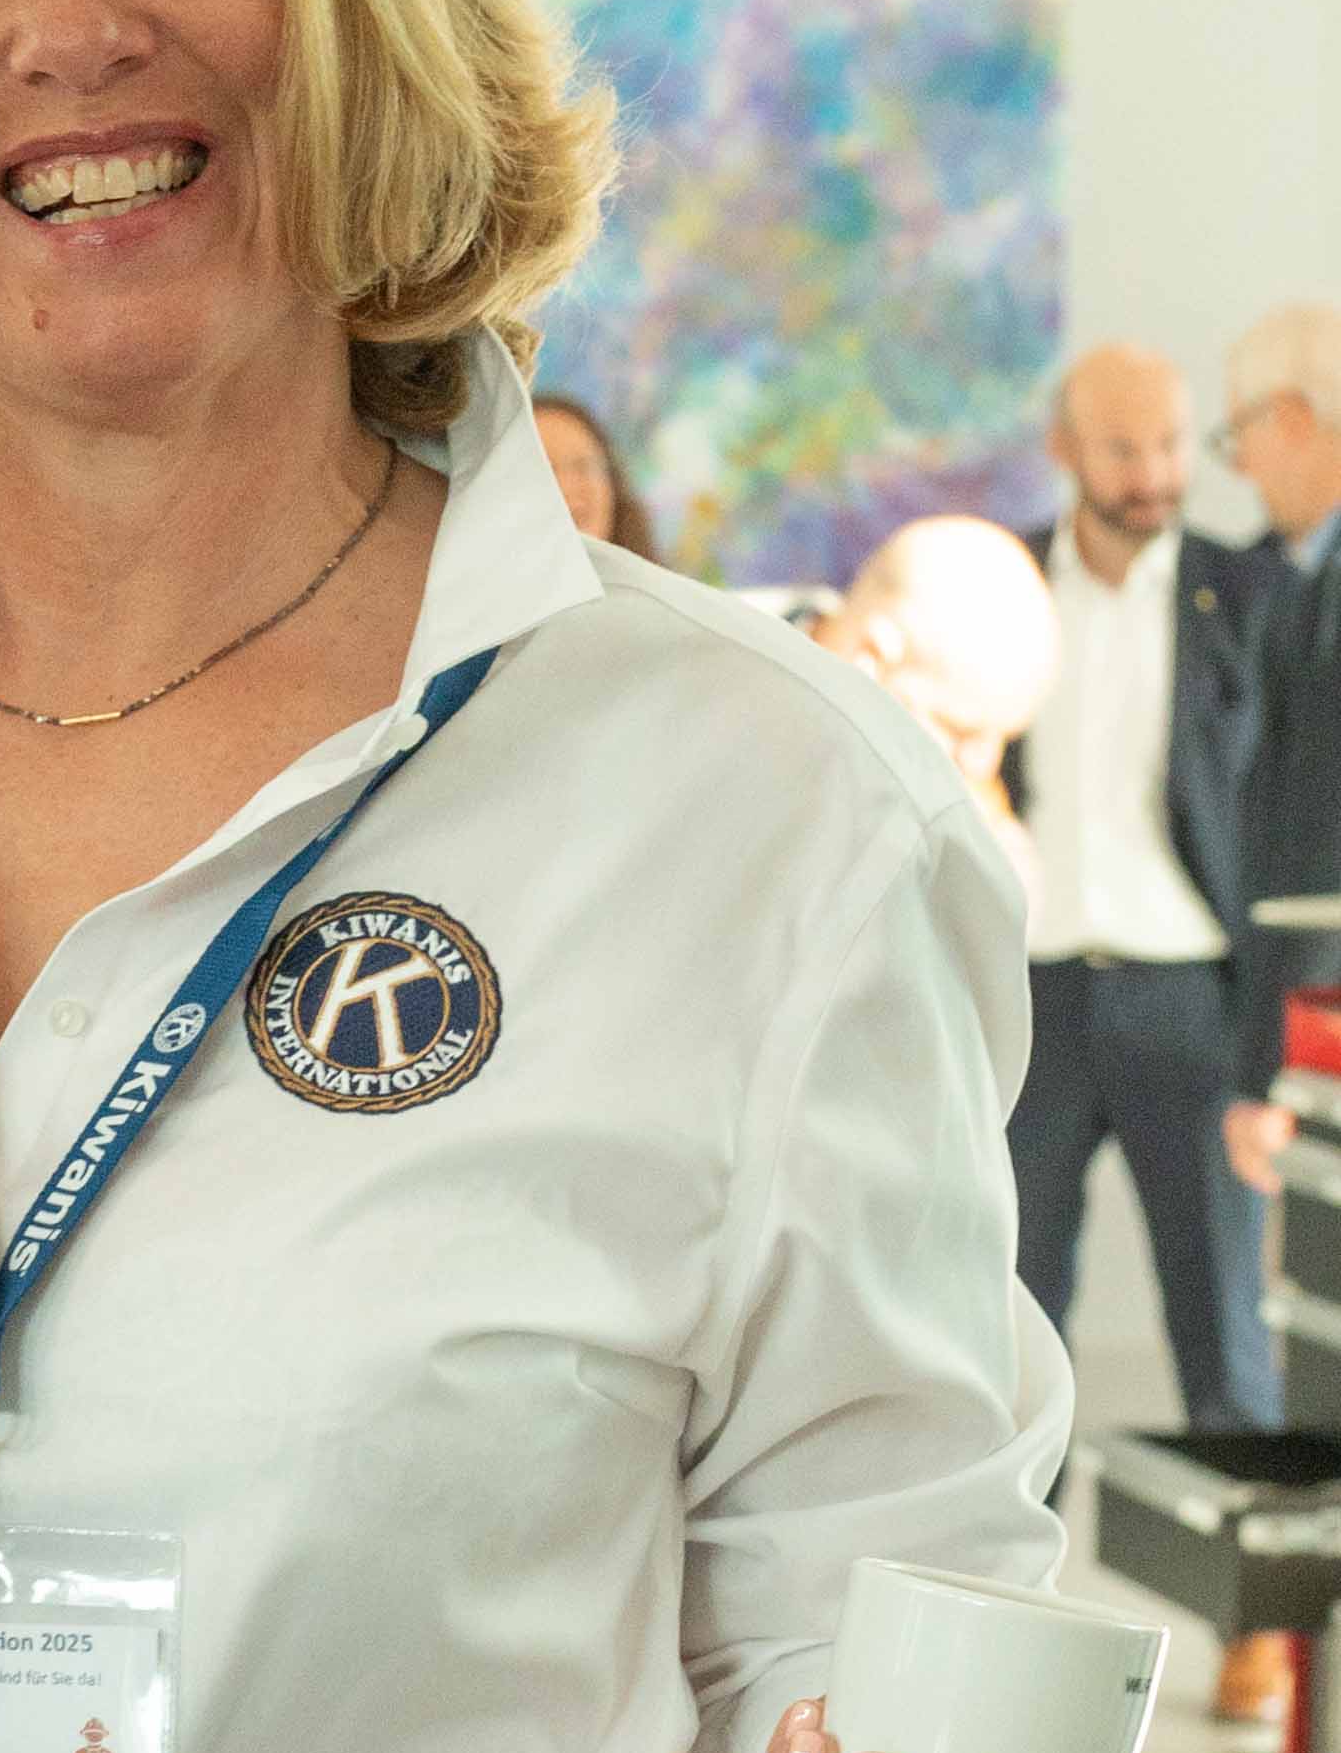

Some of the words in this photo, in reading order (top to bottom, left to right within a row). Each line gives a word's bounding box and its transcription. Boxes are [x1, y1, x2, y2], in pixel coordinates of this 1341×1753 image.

[319, 914, 471, 984] KIWANIS
[266, 974, 474, 1095] INTERNATIONAL
[308, 940, 438, 1067] K
[7, 1062, 171, 1275] Kiwanis
[26, 1670, 46, 1685] für
[51, 1672, 74, 1686] Sie
[41, 1634, 94, 1653] 2025
